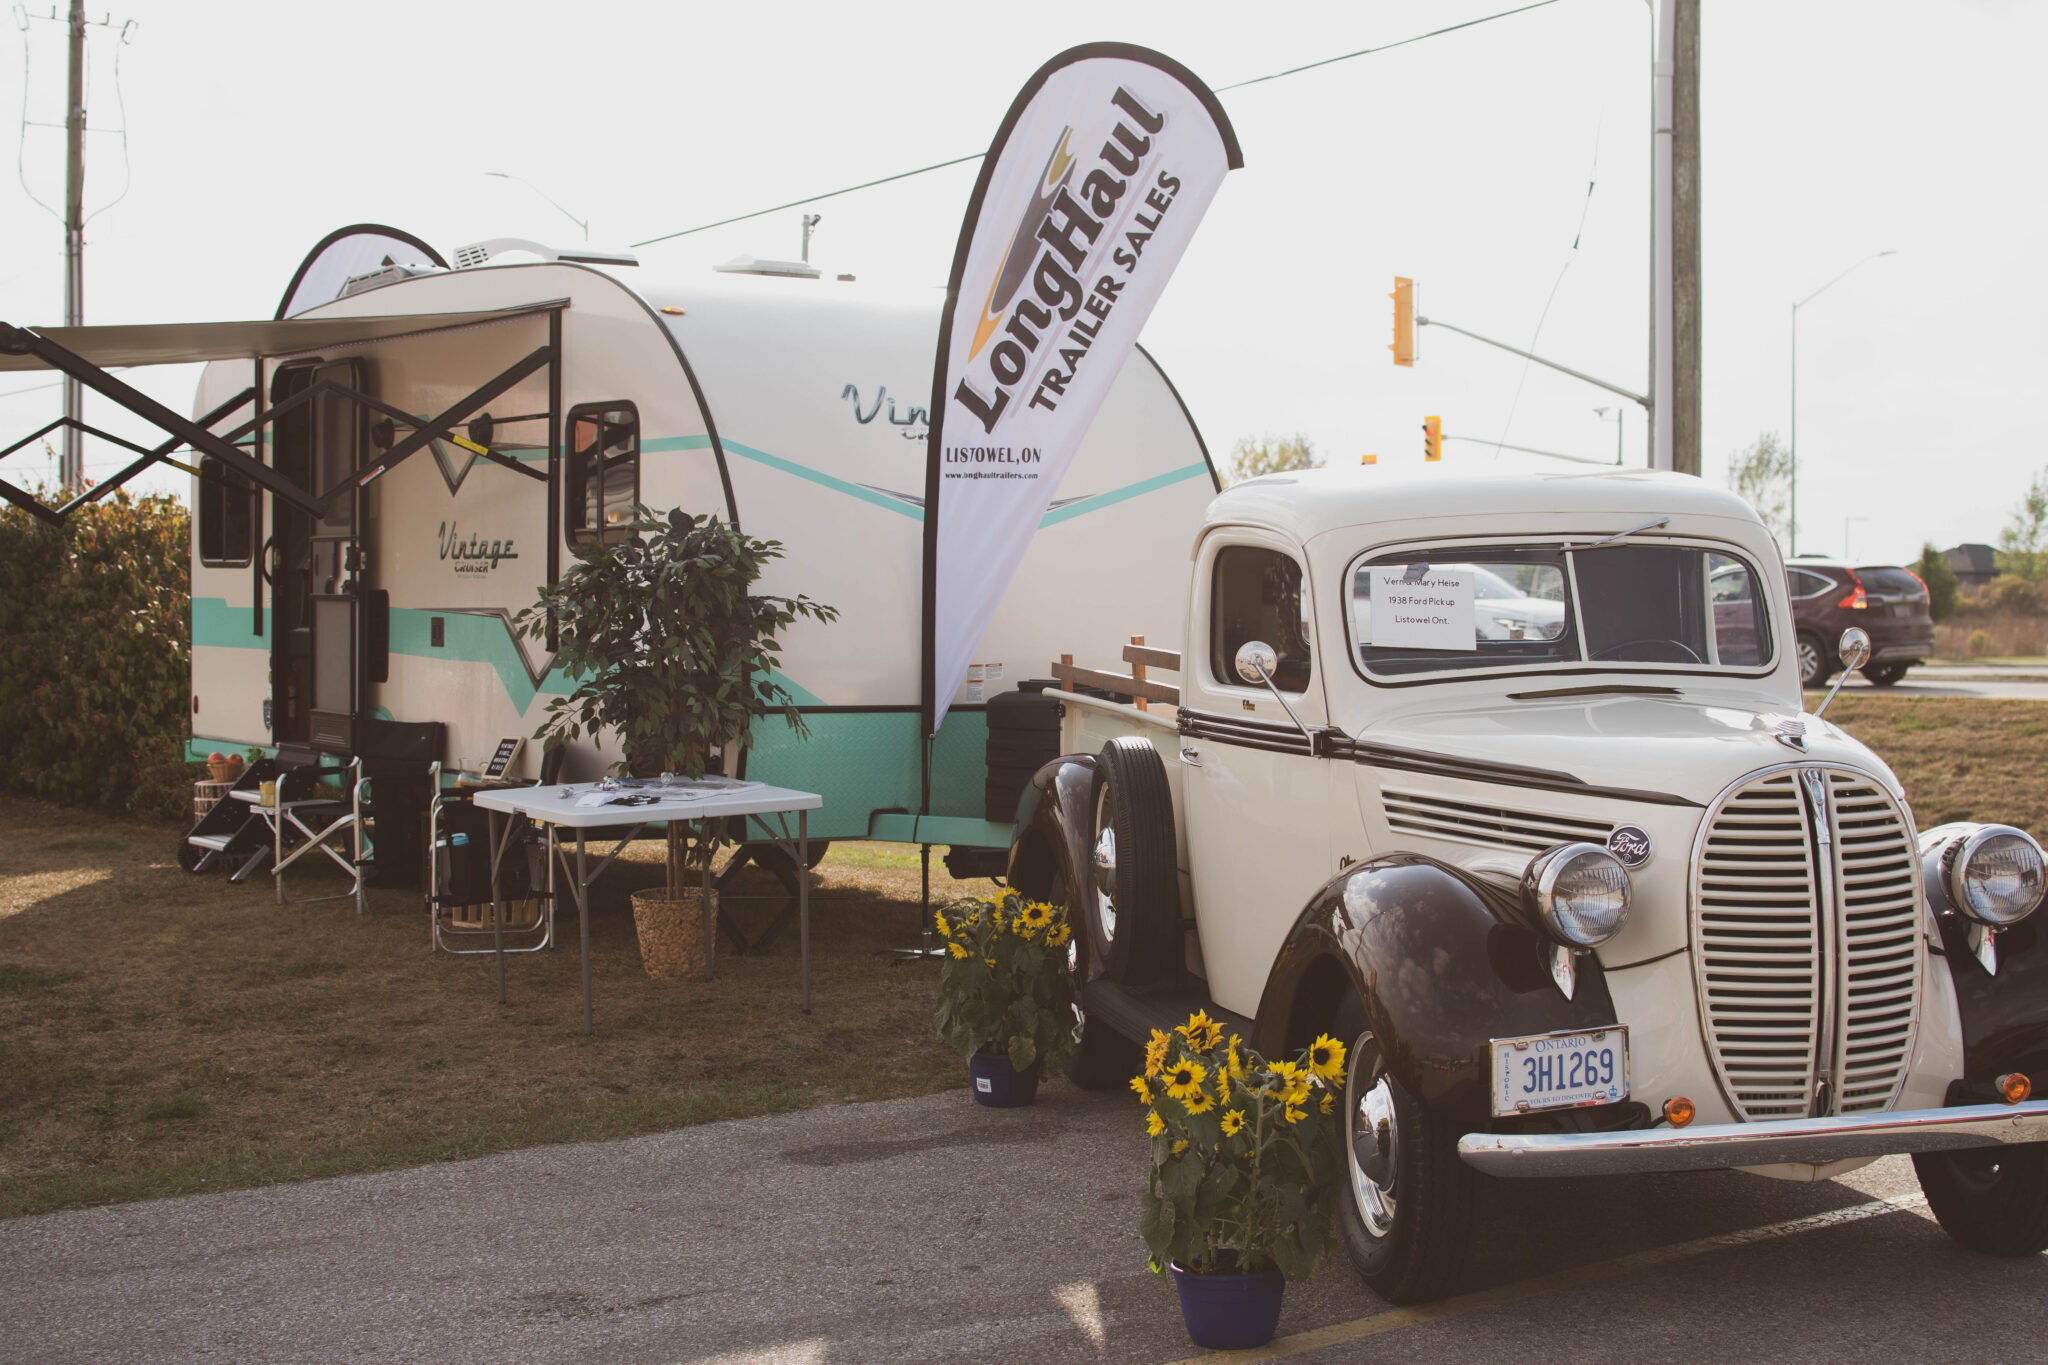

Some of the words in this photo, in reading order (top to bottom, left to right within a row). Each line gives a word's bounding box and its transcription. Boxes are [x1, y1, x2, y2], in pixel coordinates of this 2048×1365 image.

[954, 86, 1165, 434] LongHaul
[1028, 275, 1126, 412] TRAILER
[1113, 170, 1182, 274] SALES
[438, 520, 519, 570] Vintage
[1414, 579, 1435, 588] Mary
[1437, 578, 1460, 587] Heise
[1388, 596, 1407, 605] 1938
[1408, 597, 1428, 605] Ford
[1395, 616, 1430, 624] Listowel
[1431, 616, 1450, 625] Ont.
[1610, 832, 1648, 856] Ford
[1523, 1048, 1614, 1093] 3H1269
[1561, 1092, 1592, 1101] DISCOVER
